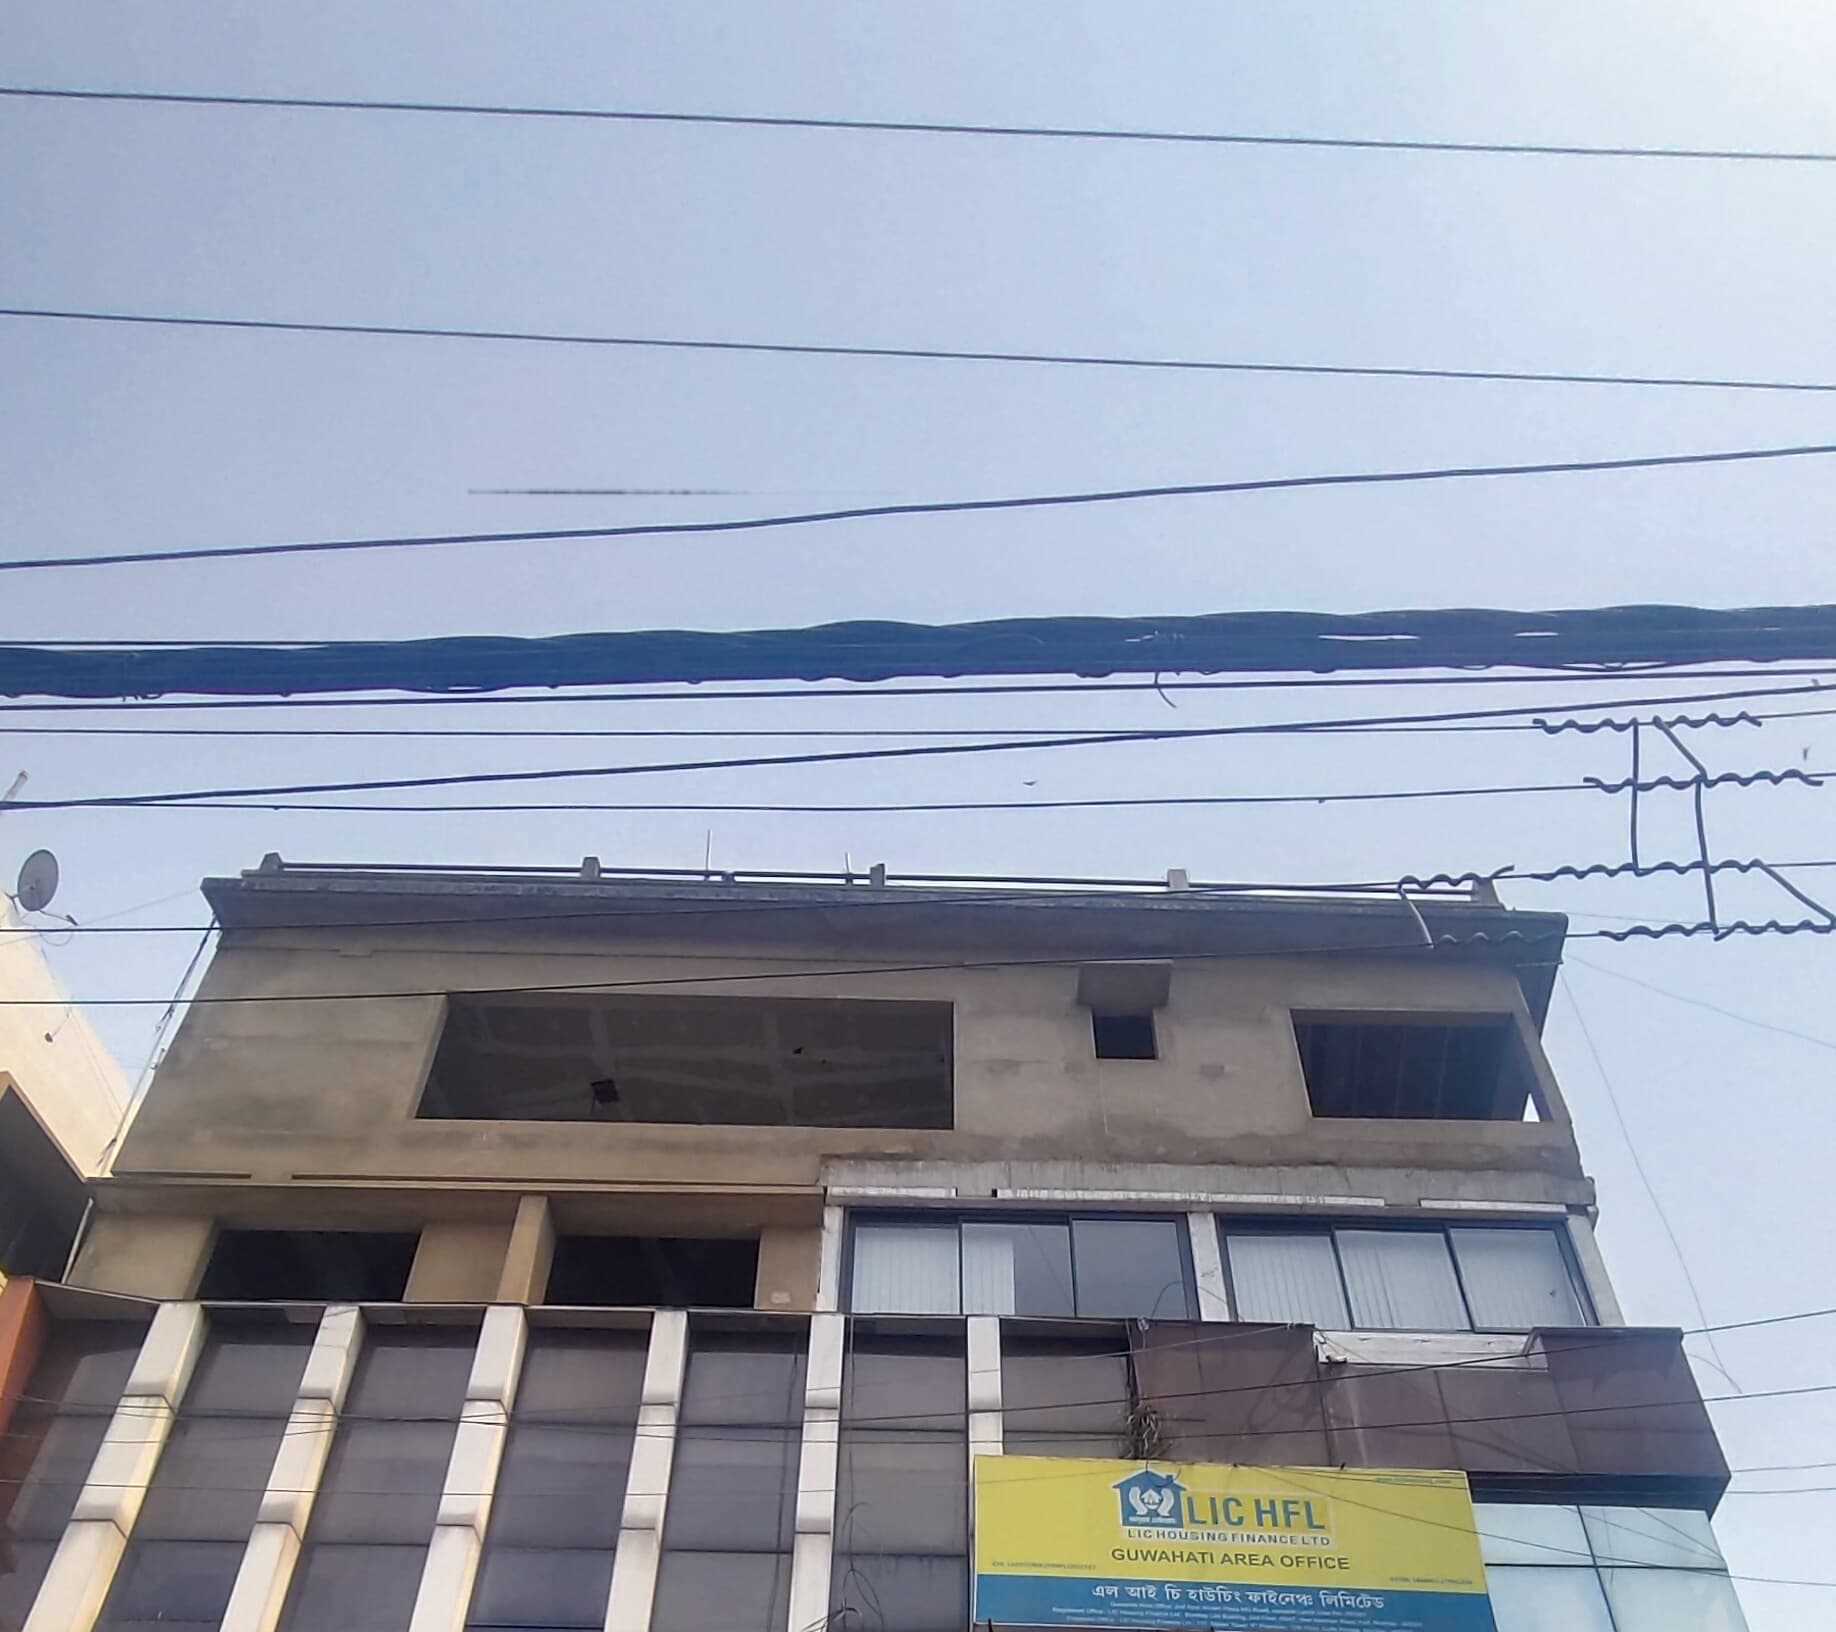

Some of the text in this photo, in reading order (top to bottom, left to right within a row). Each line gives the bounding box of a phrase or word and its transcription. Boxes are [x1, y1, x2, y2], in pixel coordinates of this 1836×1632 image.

[1187, 1496, 1327, 1530] LIC HFL
[1128, 1528, 1331, 1546] LIC HOUSING FINANCE LTD
[1111, 1548, 1351, 1570] GUWAHATI AREA OFFICE
[1092, 1586, 1119, 1599] এল
[1125, 1584, 1157, 1600] আই
[1318, 1590, 1385, 1609] লিমিটেড
